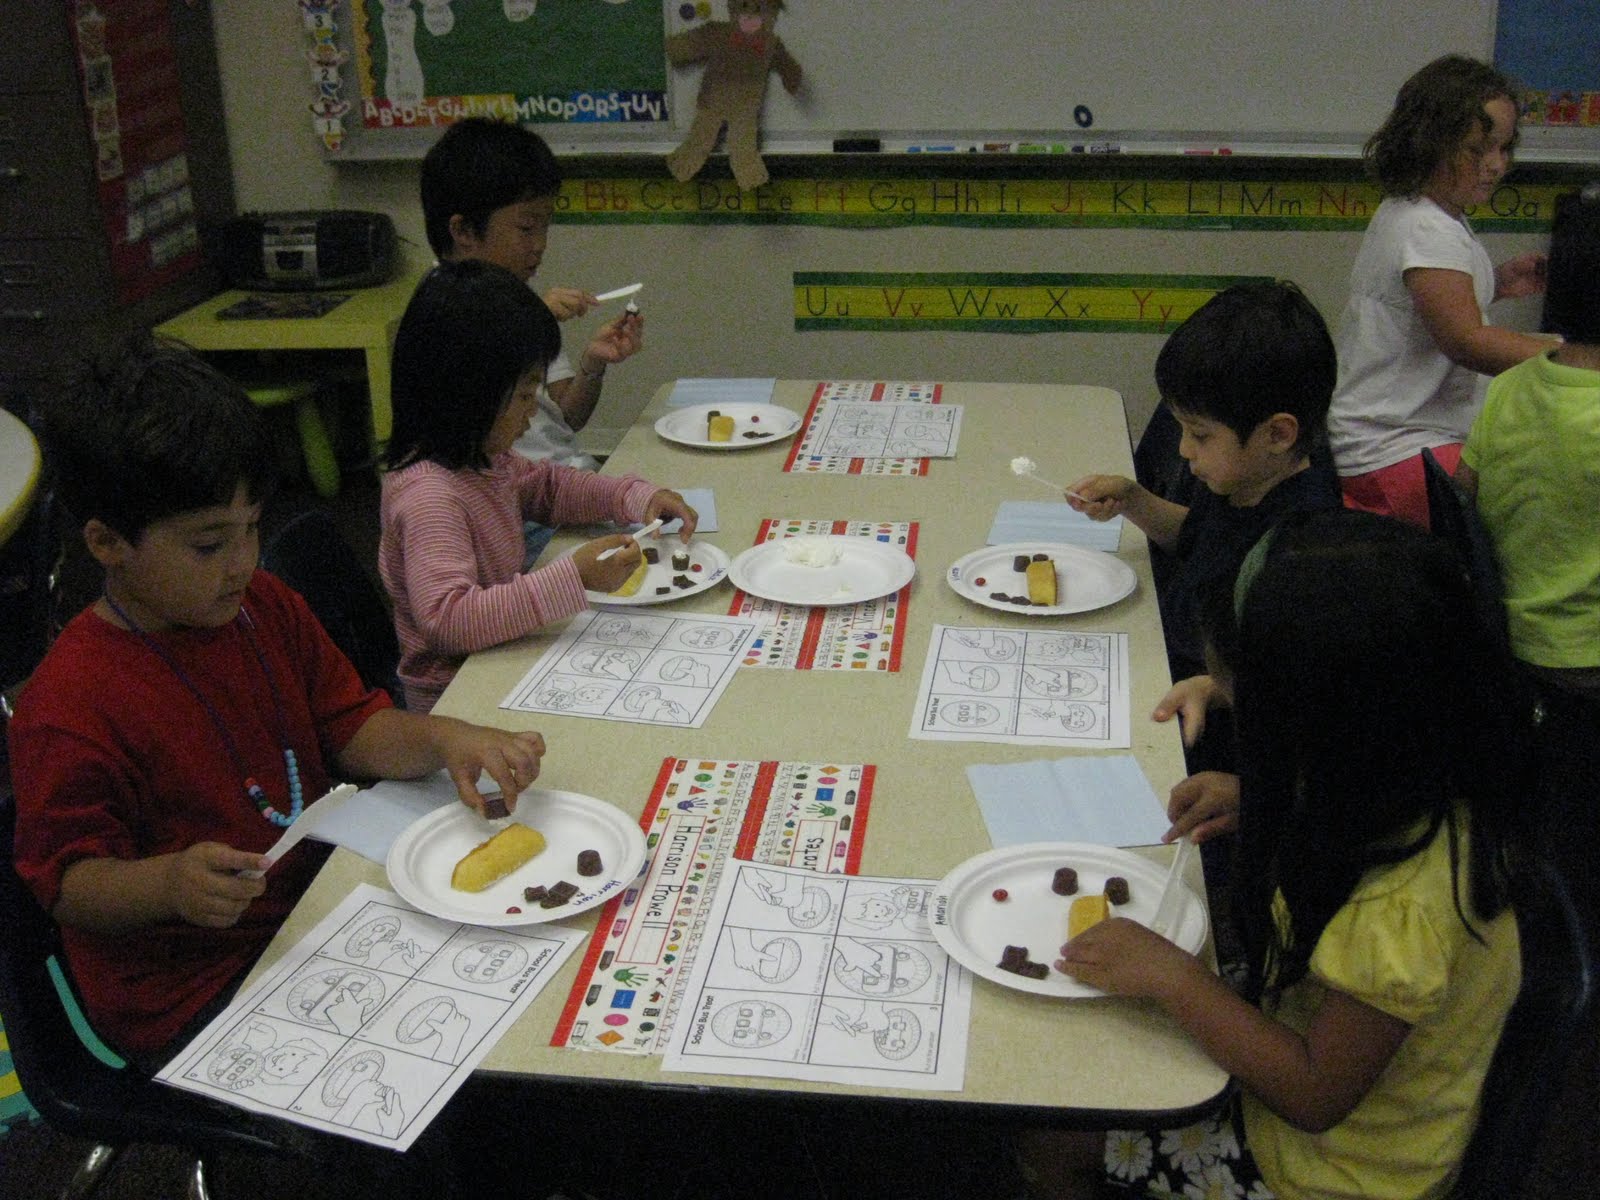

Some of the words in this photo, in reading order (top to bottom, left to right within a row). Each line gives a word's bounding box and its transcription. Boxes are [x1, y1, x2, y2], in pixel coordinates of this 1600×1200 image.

[585, 181, 629, 211] Bb
[868, 181, 916, 220] Gg
[932, 181, 979, 213] Hh
[1113, 182, 1156, 214] Kk
[1240, 183, 1303, 216] Mm
[1317, 185, 1368, 217] Nn
[805, 287, 849, 317] Uu
[882, 288, 923, 318] Vv
[947, 288, 1018, 317] Ww
[1045, 288, 1090, 318] Xx
[1132, 289, 1174, 332] Yy
[661, 825, 704, 876] Harrison
[641, 884, 684, 930] Prowell
[531, 948, 553, 967] School
[522, 966, 537, 978] Bus
[702, 995, 715, 1011] Treat
[698, 1011, 710, 1023] Bus
[690, 1023, 706, 1045] School
